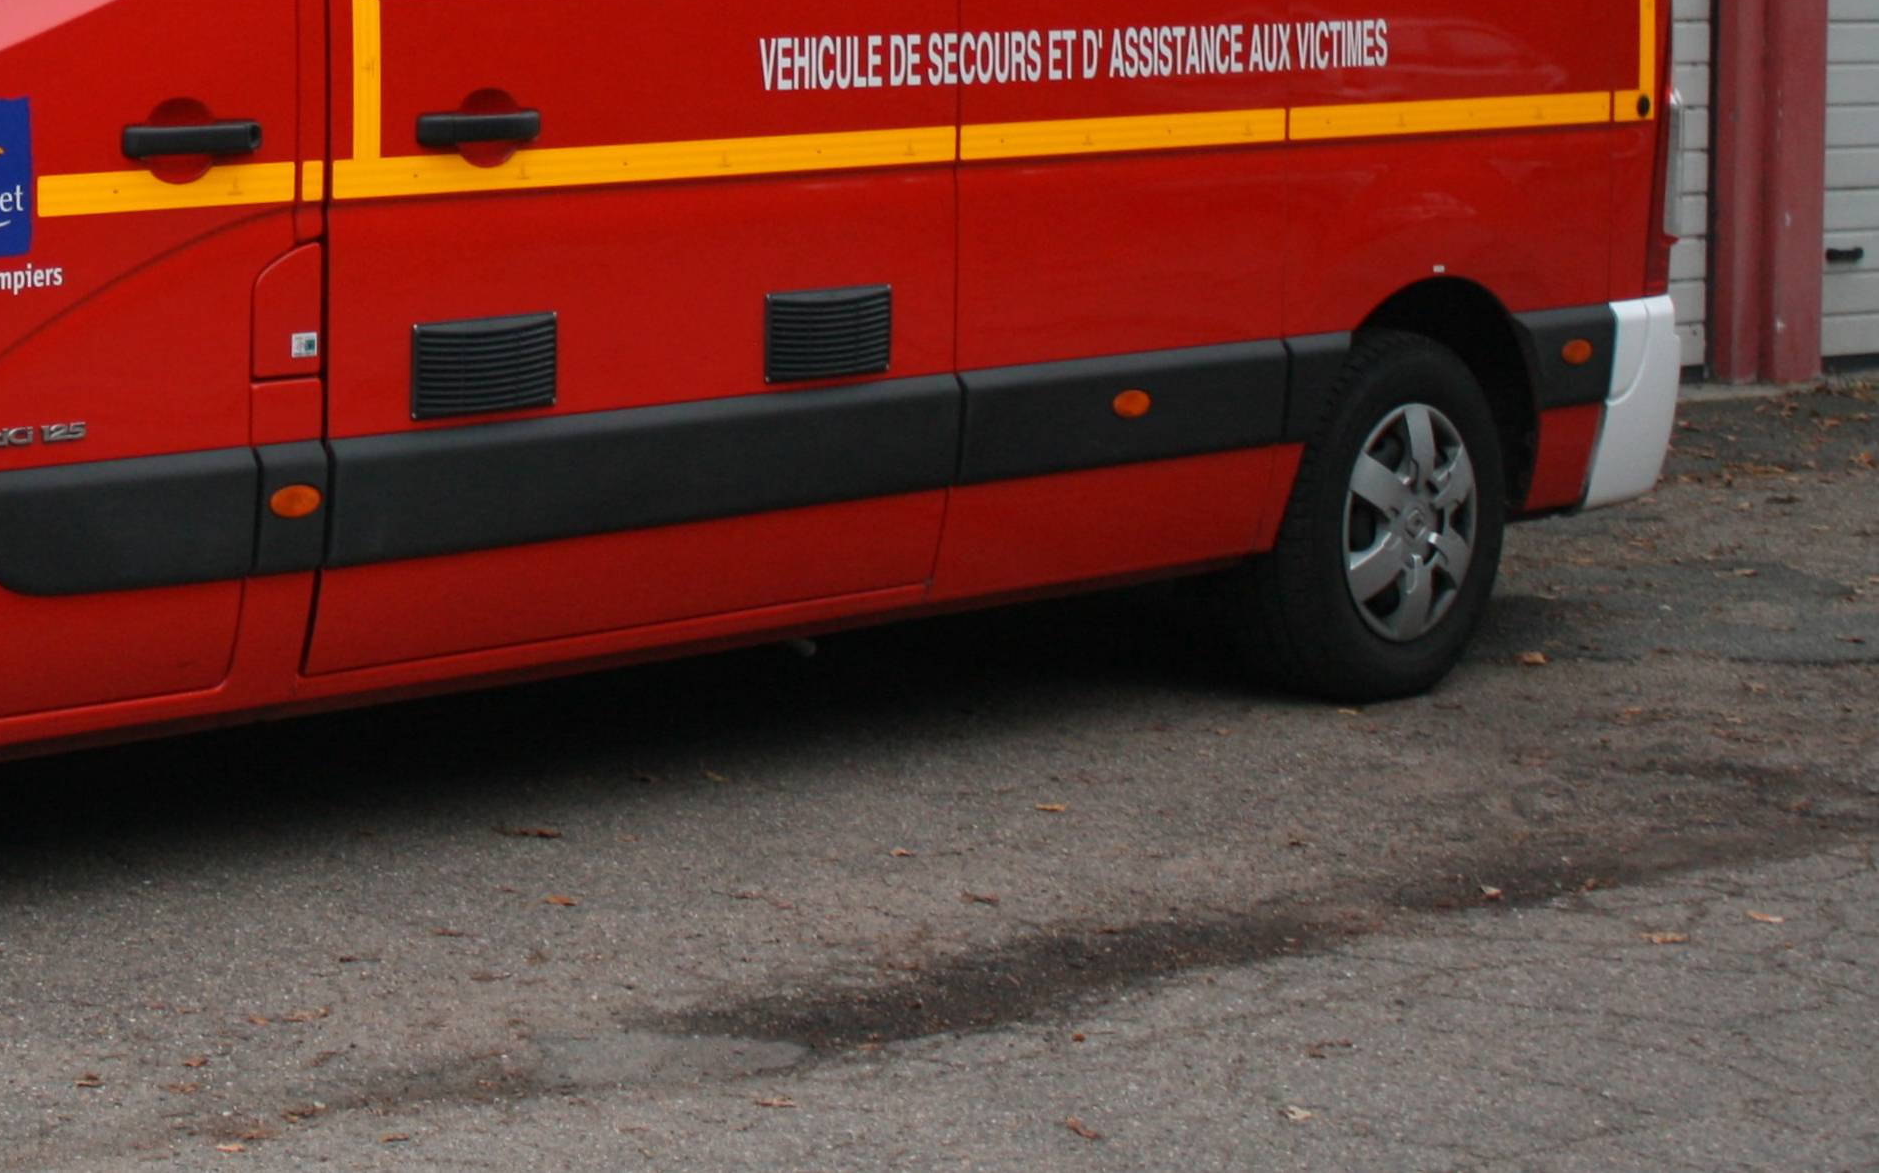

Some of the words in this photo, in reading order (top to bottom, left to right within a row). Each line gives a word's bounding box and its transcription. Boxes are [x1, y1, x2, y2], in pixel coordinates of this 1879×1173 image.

[759, 34, 883, 91] VEHICULE
[889, 33, 922, 87] DE
[927, 29, 1042, 86] SECOURS
[1048, 29, 1077, 81] ET
[1082, 28, 1104, 79] D'
[1109, 24, 1244, 78] ASSISTANCE
[1248, 23, 1291, 72] AUX
[1296, 18, 1389, 70] VICTIMES
[41, 421, 87, 443] 125
